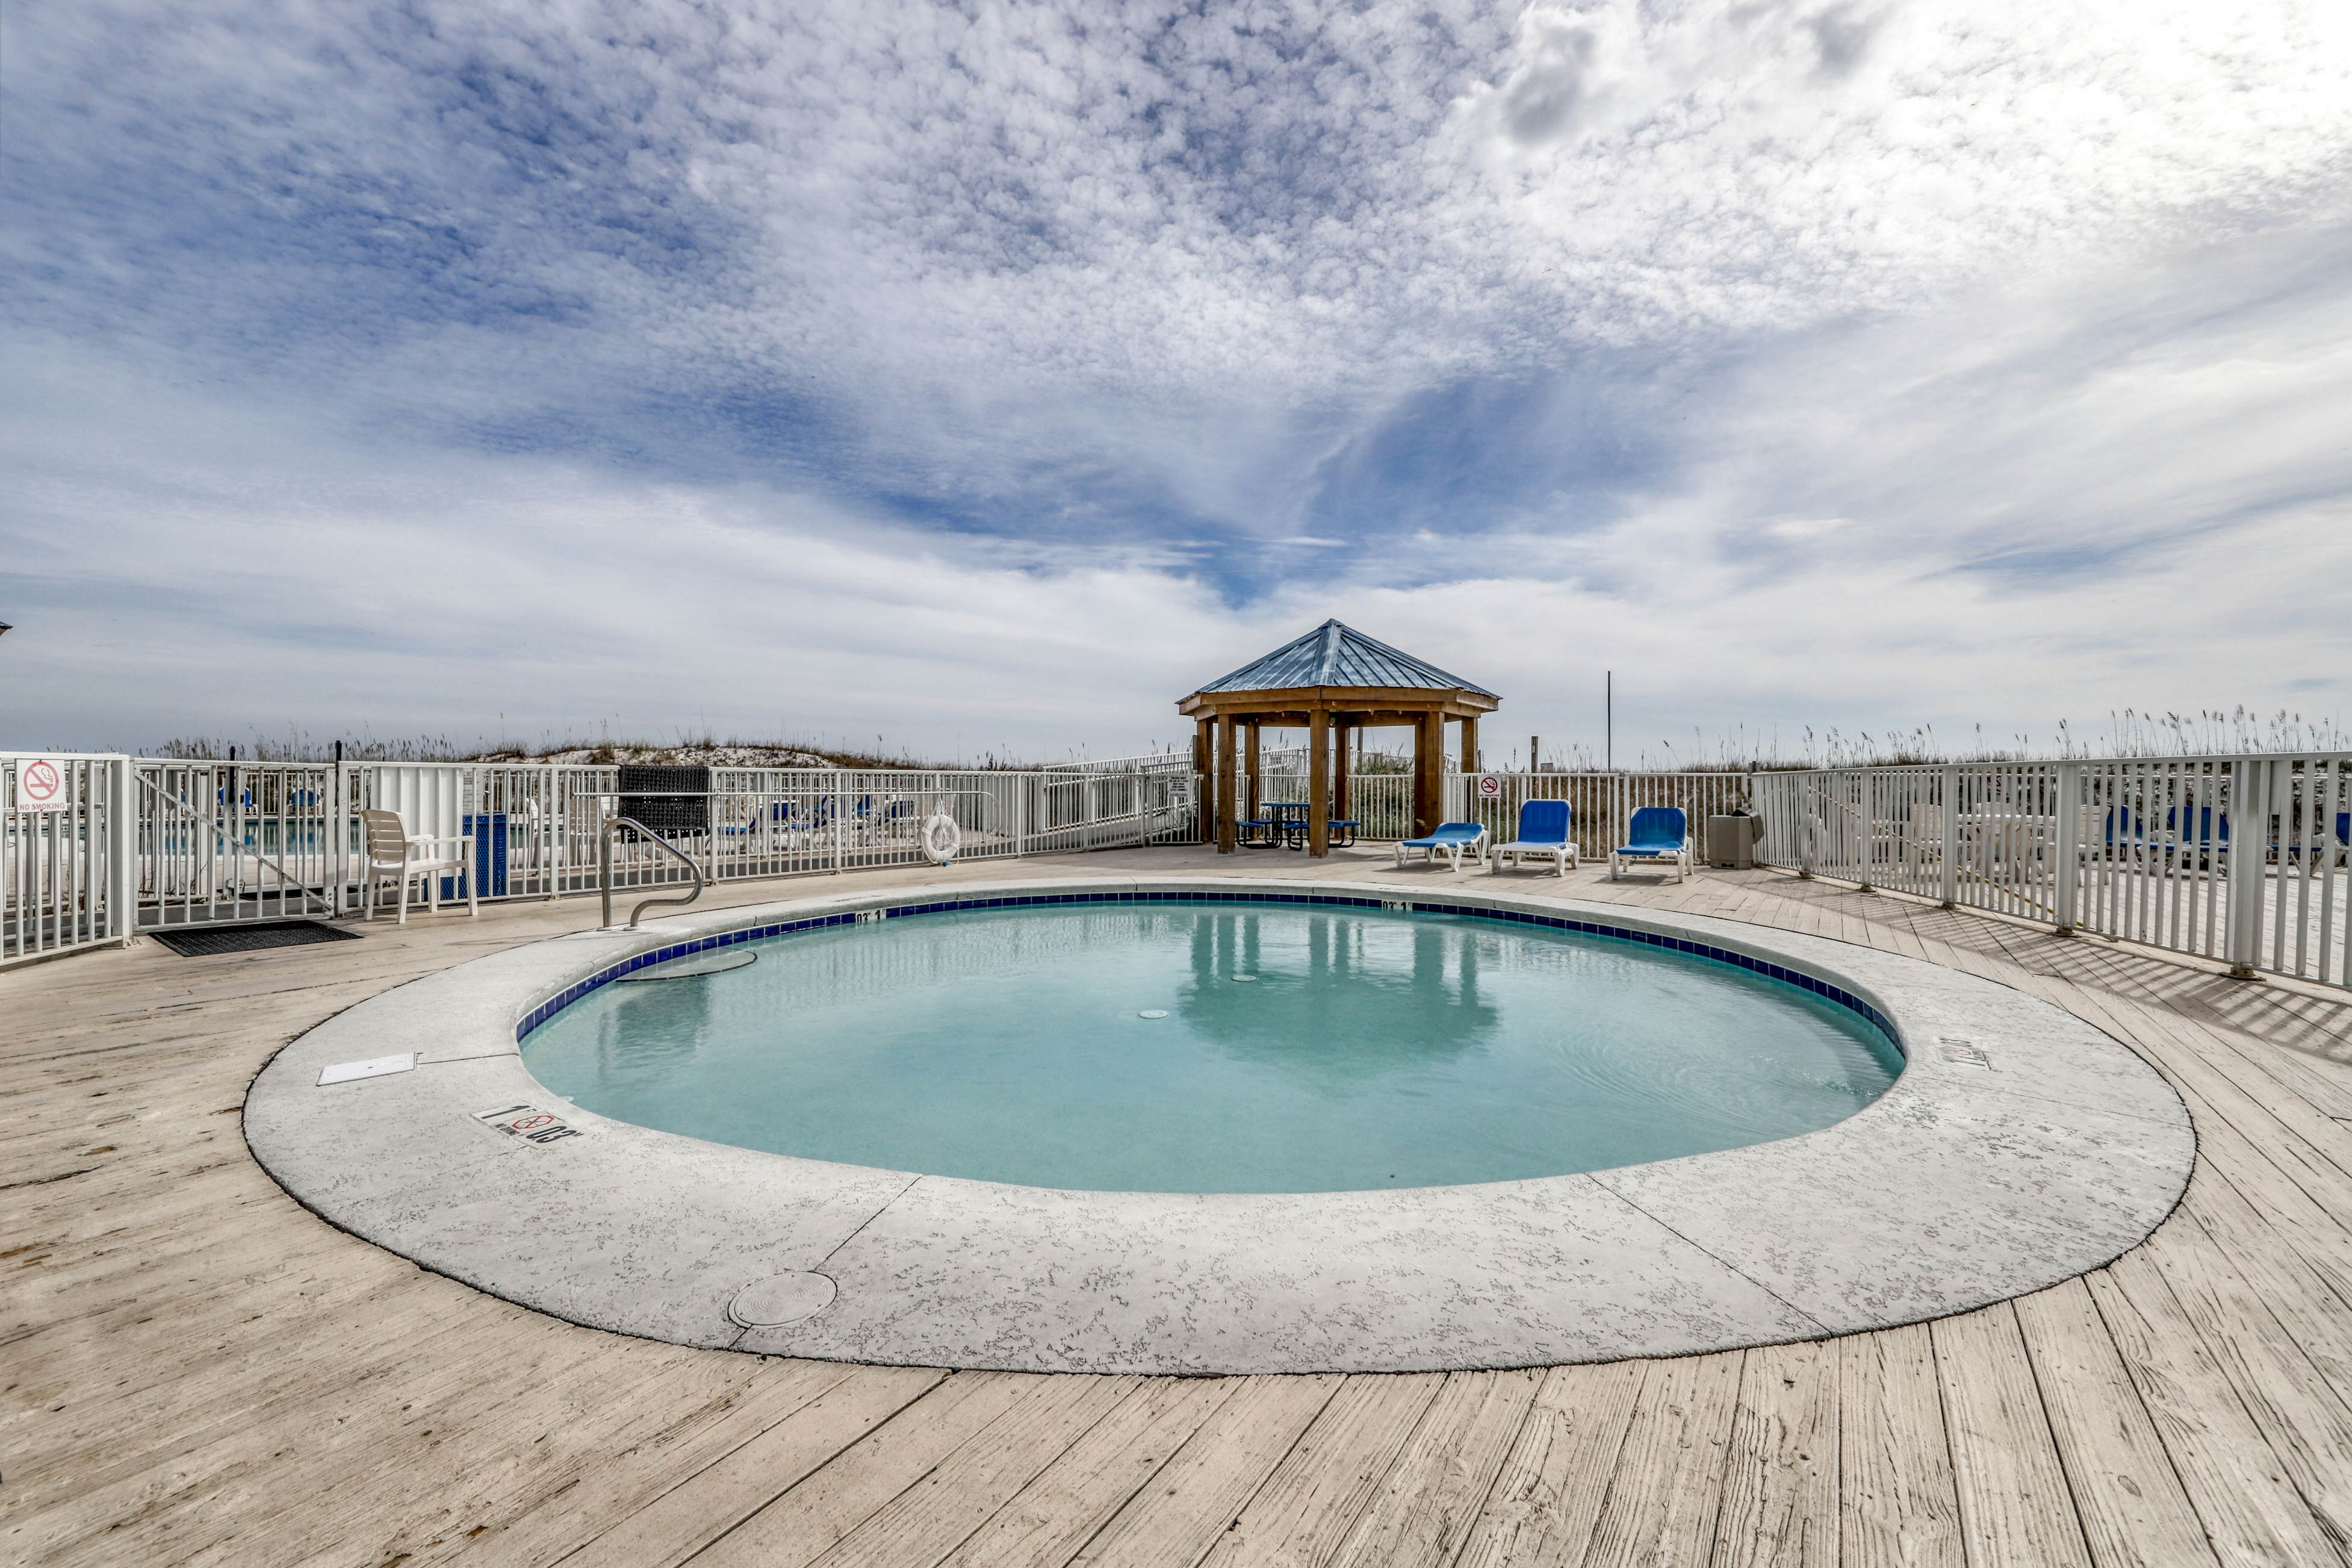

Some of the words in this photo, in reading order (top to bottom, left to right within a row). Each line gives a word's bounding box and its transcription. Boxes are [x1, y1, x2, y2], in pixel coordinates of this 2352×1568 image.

[1401, 902, 1406, 910] 1
[875, 910, 881, 920] 1
[480, 1105, 530, 1120] 1
